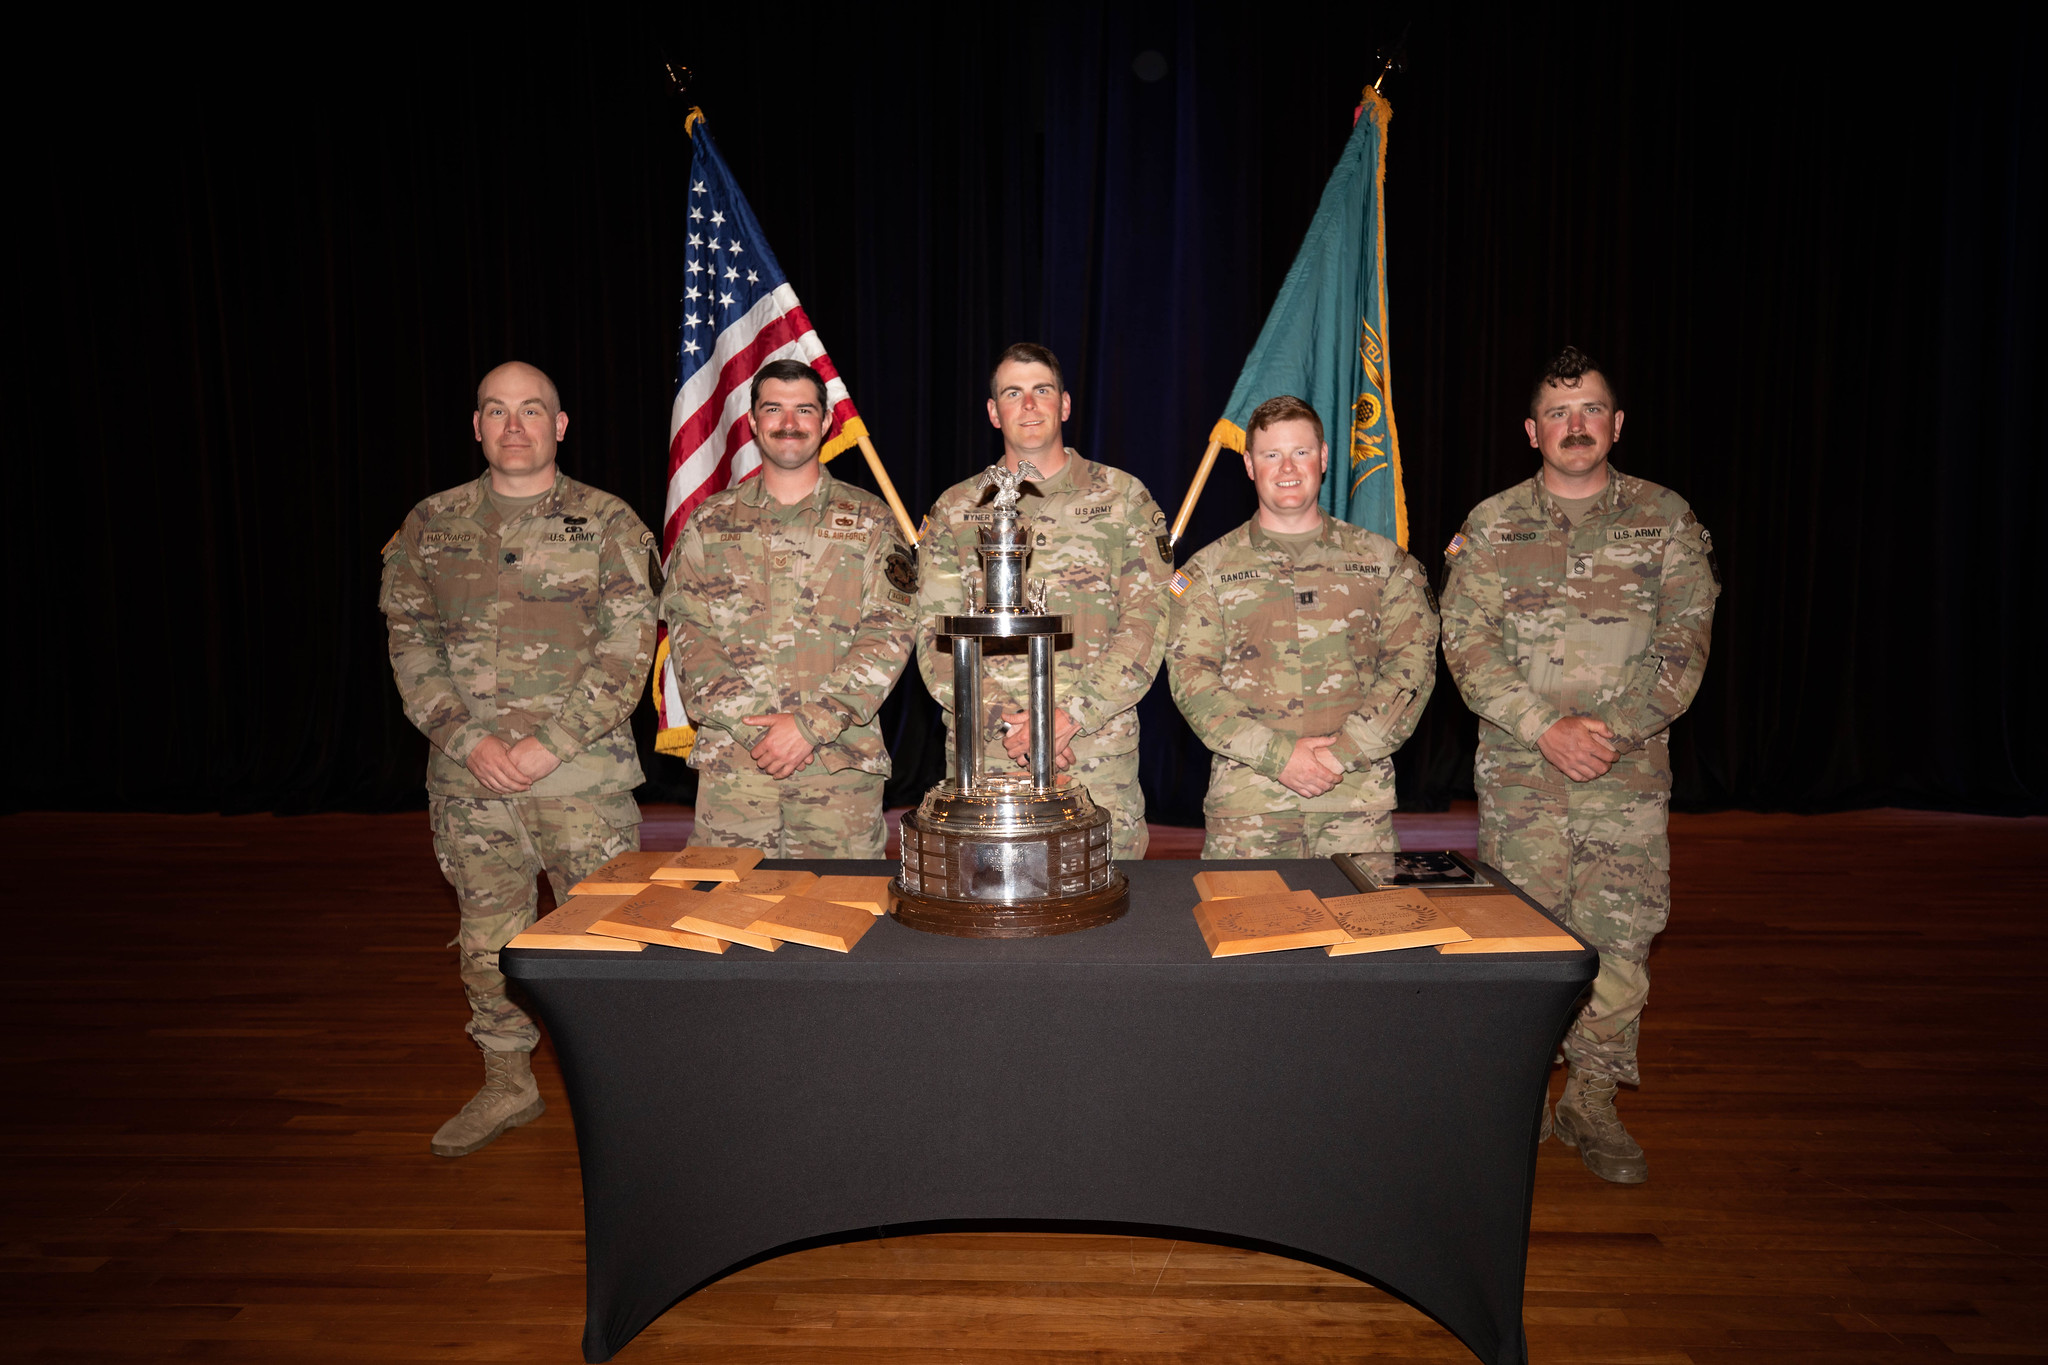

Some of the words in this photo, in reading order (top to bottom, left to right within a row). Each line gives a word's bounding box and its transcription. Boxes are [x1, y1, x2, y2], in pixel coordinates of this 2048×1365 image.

[1090, 505, 1112, 514] ARMY
[963, 513, 990, 521] WYNER
[426, 533, 471, 542] HAYWARD
[550, 533, 566, 541] U.S.
[569, 533, 595, 541] ARMY
[817, 529, 830, 538] U.S.
[832, 531, 844, 540] AIR
[845, 532, 867, 542] FORCE
[1501, 532, 1536, 542] MUSSO
[1614, 531, 1632, 540] U.S.
[1634, 529, 1662, 538] ARMY
[1359, 565, 1381, 575] ARMY
[1220, 570, 1260, 583] RANDALL
